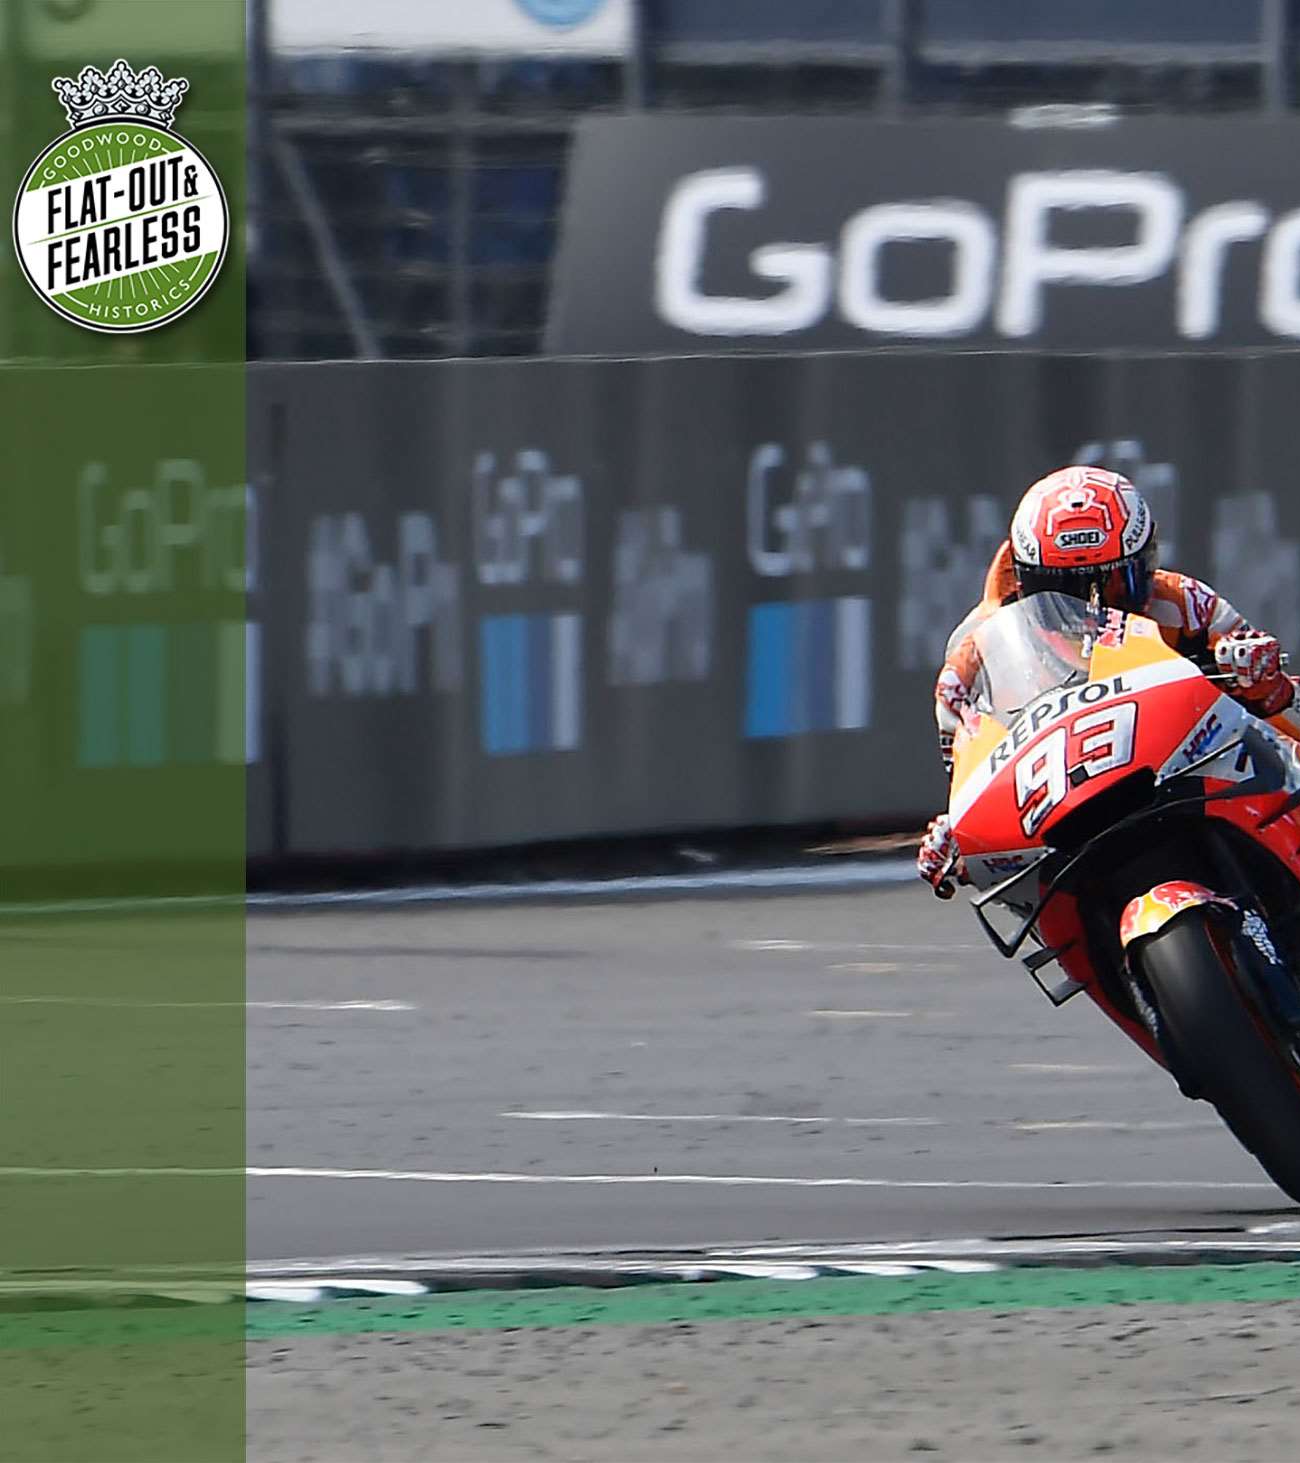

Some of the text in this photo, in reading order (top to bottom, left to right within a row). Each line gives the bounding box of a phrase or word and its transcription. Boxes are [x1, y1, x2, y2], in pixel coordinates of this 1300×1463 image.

[1060, 531, 1099, 547] SHOEI
[990, 676, 1132, 774] REPSOL
[1183, 713, 1223, 765] HRC
[1014, 701, 1138, 838] 93
